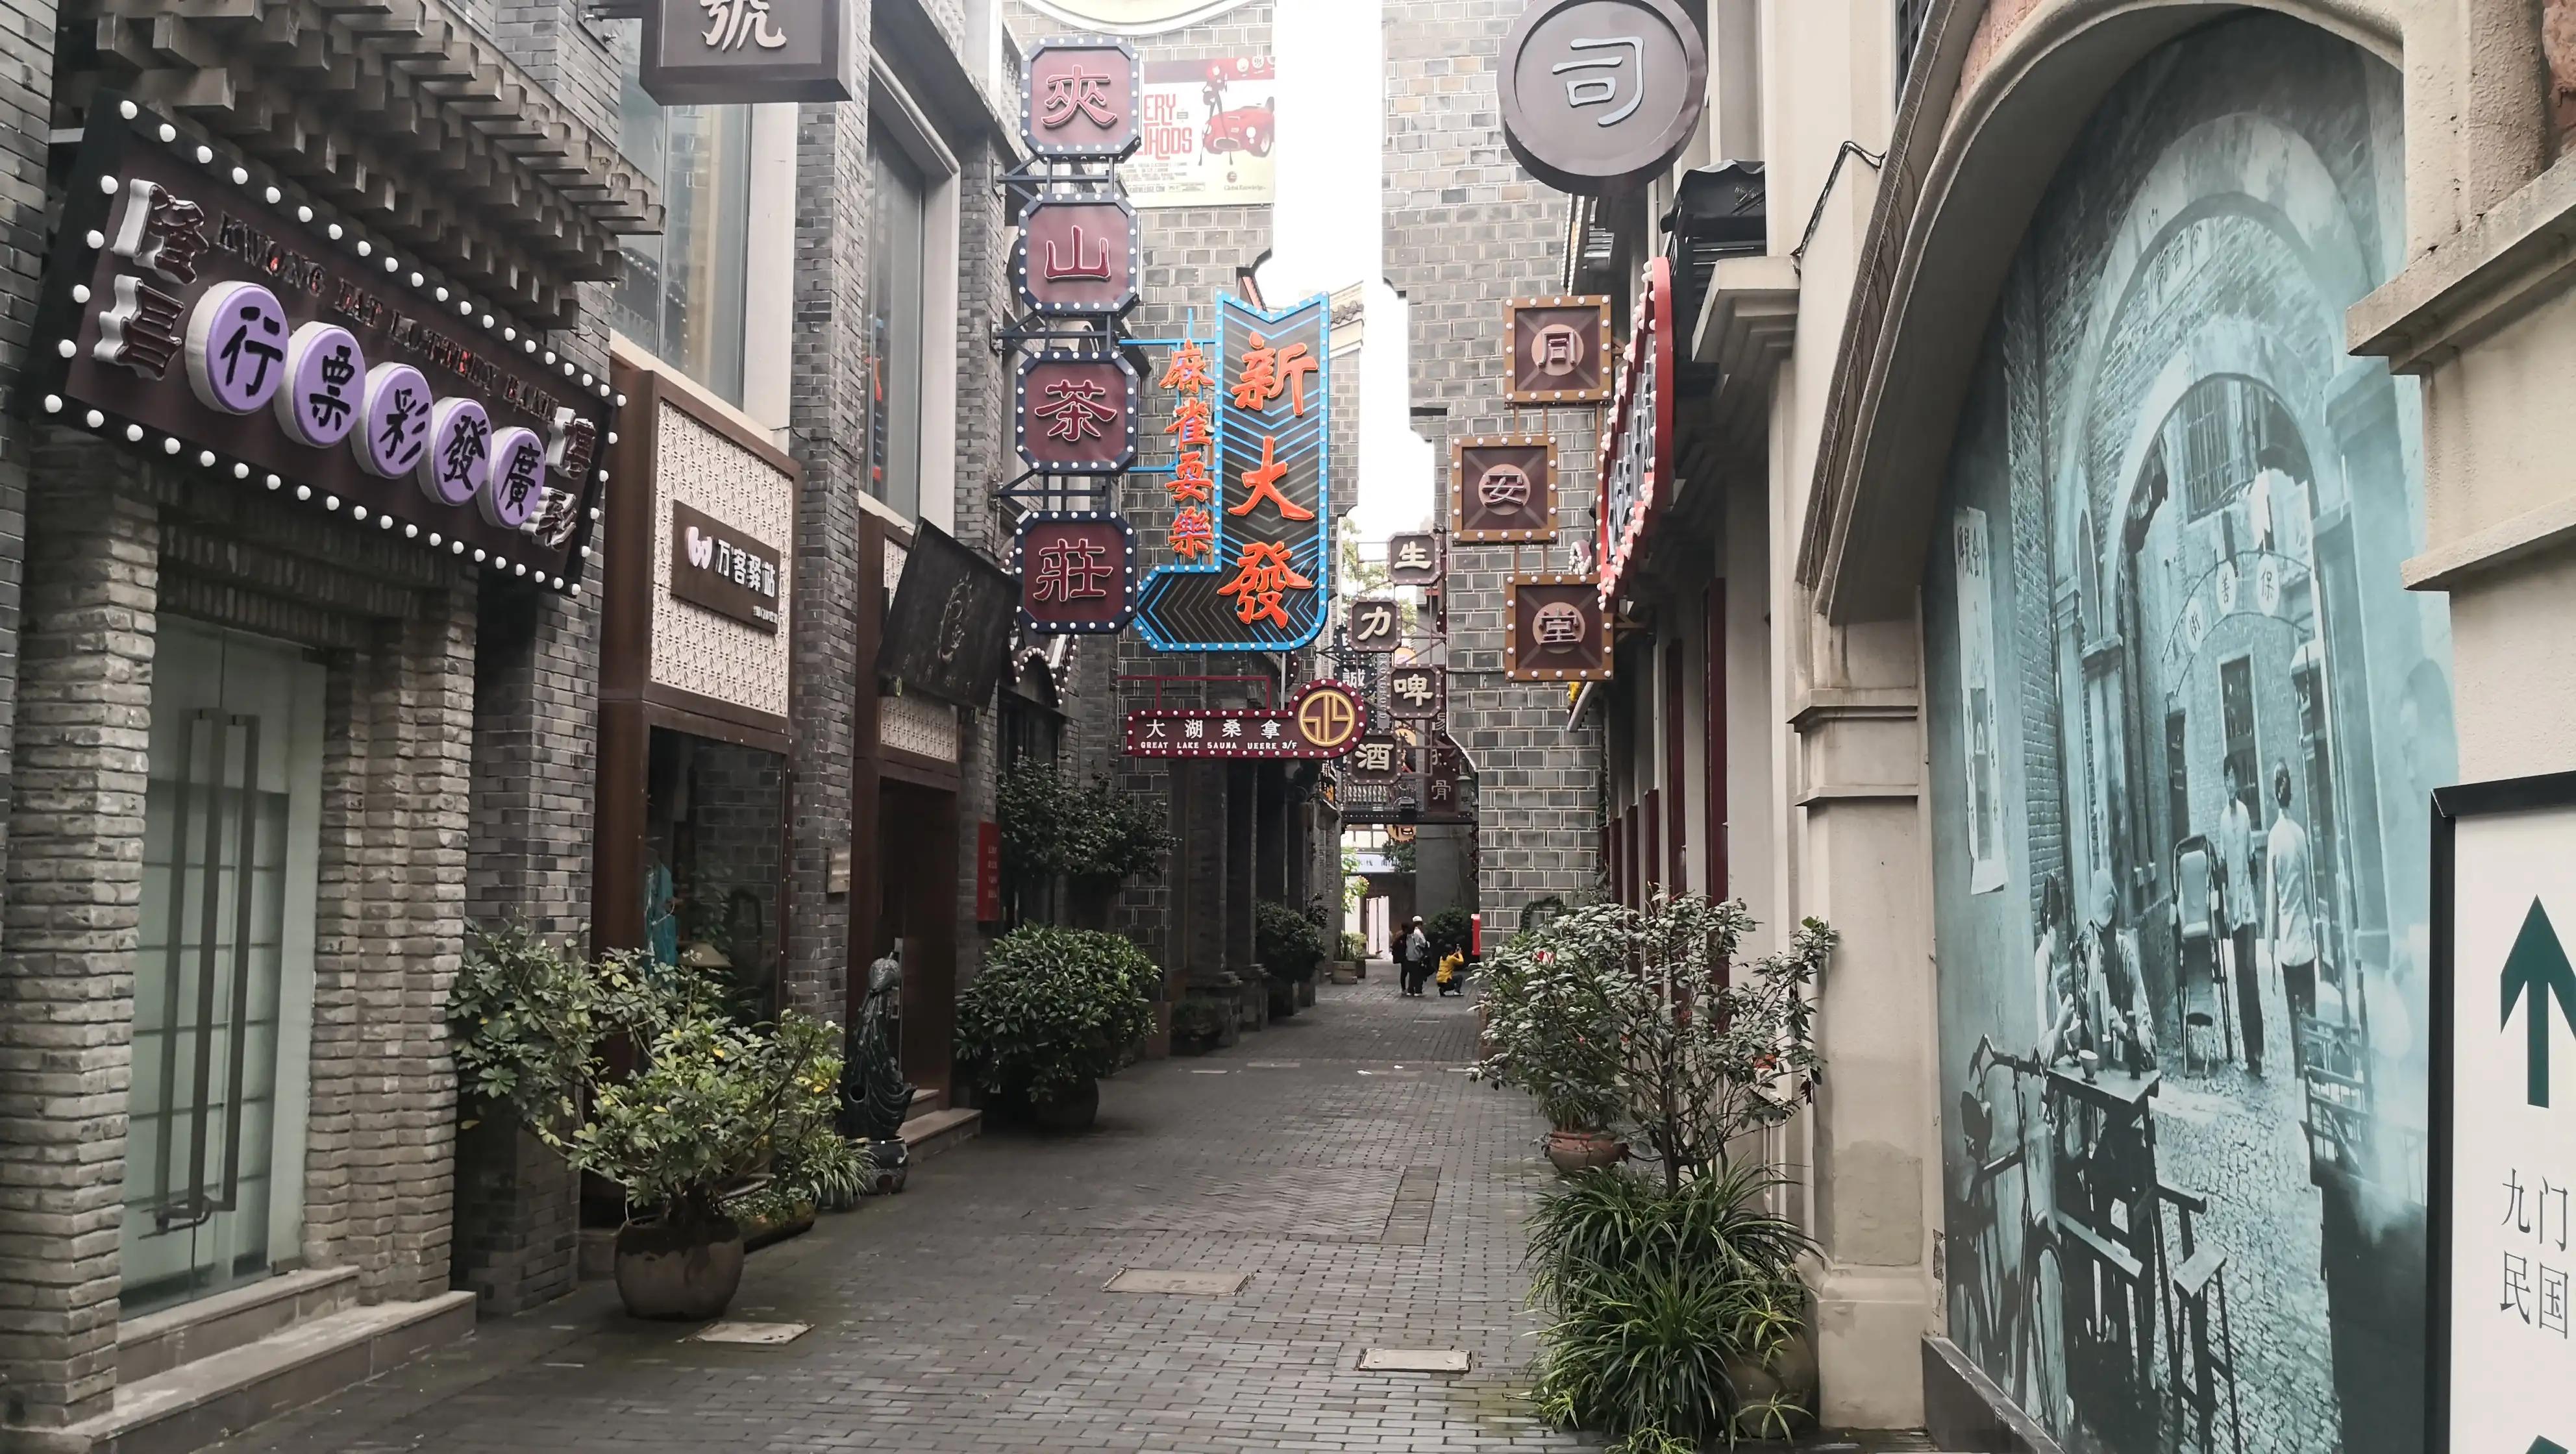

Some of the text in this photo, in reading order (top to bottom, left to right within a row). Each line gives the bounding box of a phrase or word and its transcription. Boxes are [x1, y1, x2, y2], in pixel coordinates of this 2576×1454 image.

[1552, 36, 1644, 127] 司
[1135, 123, 1193, 160] THODS
[1033, 64, 1117, 602] 夾山茶莊
[1217, 331, 1319, 628] 新大發
[1354, 541, 1433, 771] 生力啤酒
[1146, 719, 1281, 739] 大湖桑拿
[1282, 739, 1298, 750] 3/F
[2501, 1168, 2568, 1252] 九门
[2499, 1250, 2569, 1340] 民国
